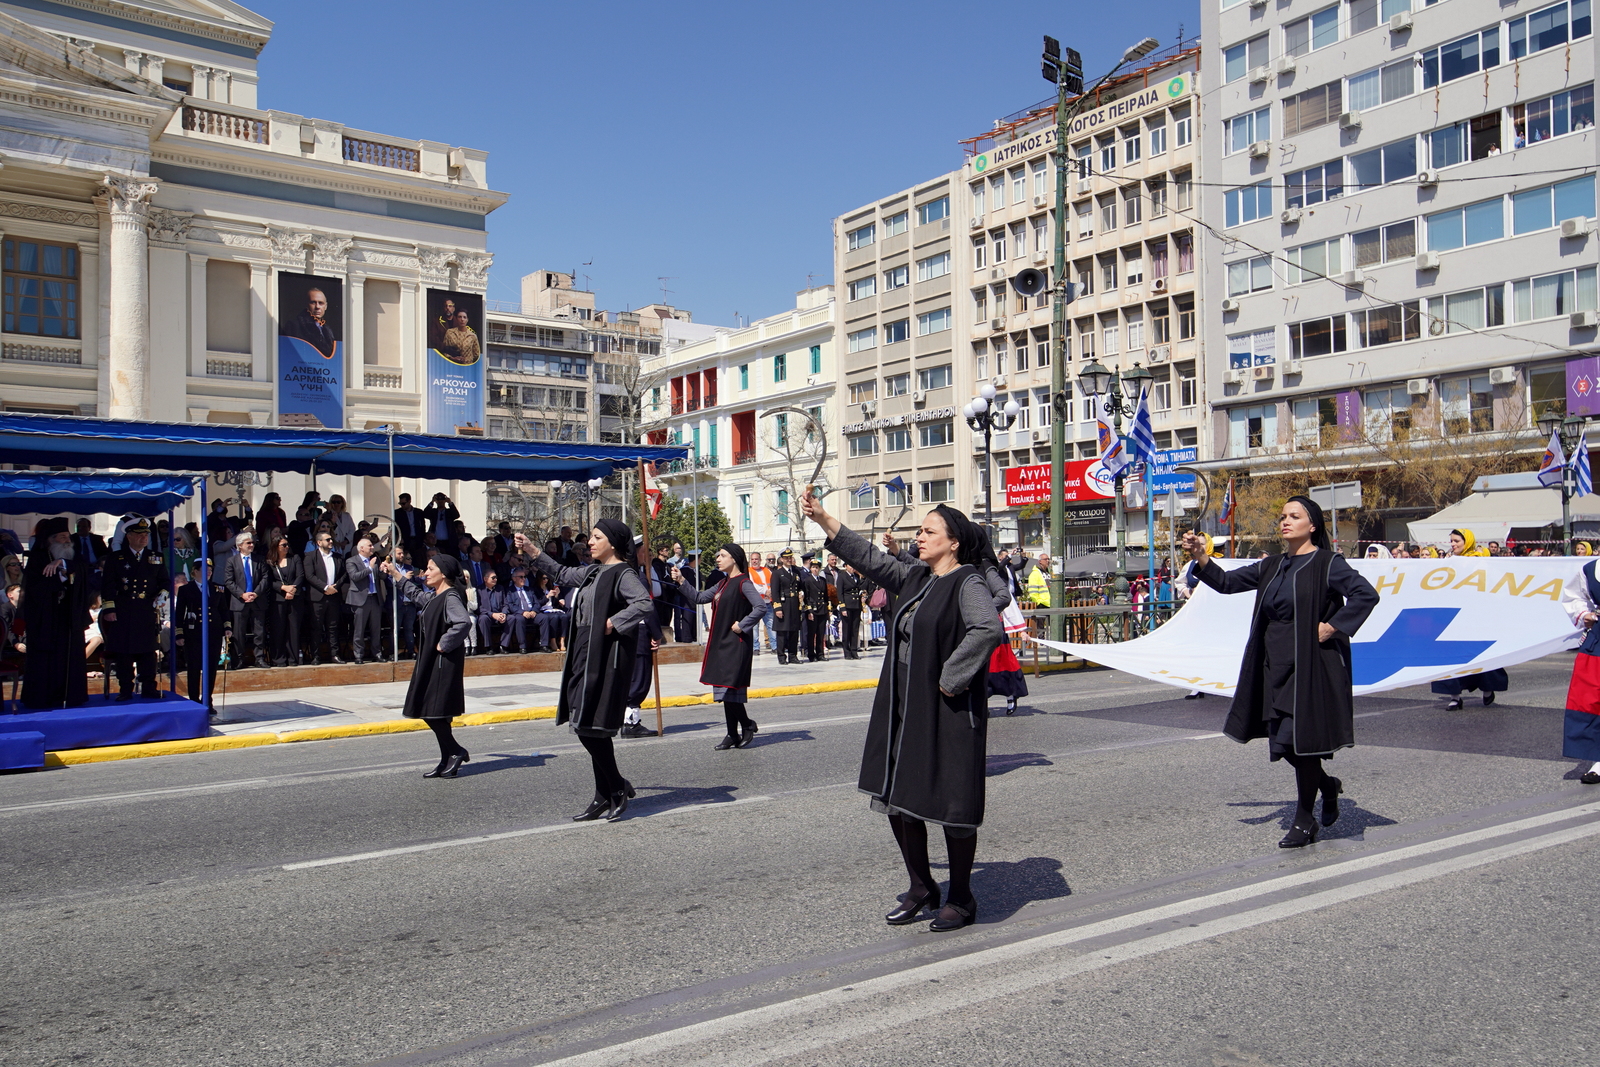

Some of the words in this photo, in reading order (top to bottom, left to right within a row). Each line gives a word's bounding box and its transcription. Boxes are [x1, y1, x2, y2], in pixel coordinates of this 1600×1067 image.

[994, 135, 1042, 164] ΙΑΤΡΙΚΟΣ
[1045, 110, 1105, 144] ΣΥΛΟΓΟΣ
[1109, 89, 1159, 119] ΠΕΙΡΑΙΑ
[291, 366, 331, 376] ΑΝΕΜΟ
[284, 374, 338, 385] ΔΑΡΜΕΝΑ
[433, 378, 477, 389] ΑΡΚΟΥΔΟ
[299, 383, 323, 392] ΥΨΗ
[442, 387, 468, 396] ΡΑΧΗ
[900, 406, 956, 424] ΕΠΙΜΕΛΗΤΗΡΙΟΝ
[1007, 482, 1036, 493] Γαλλικά
[1010, 494, 1035, 504] Ιταλικά
[1078, 507, 1106, 518] καιρού
